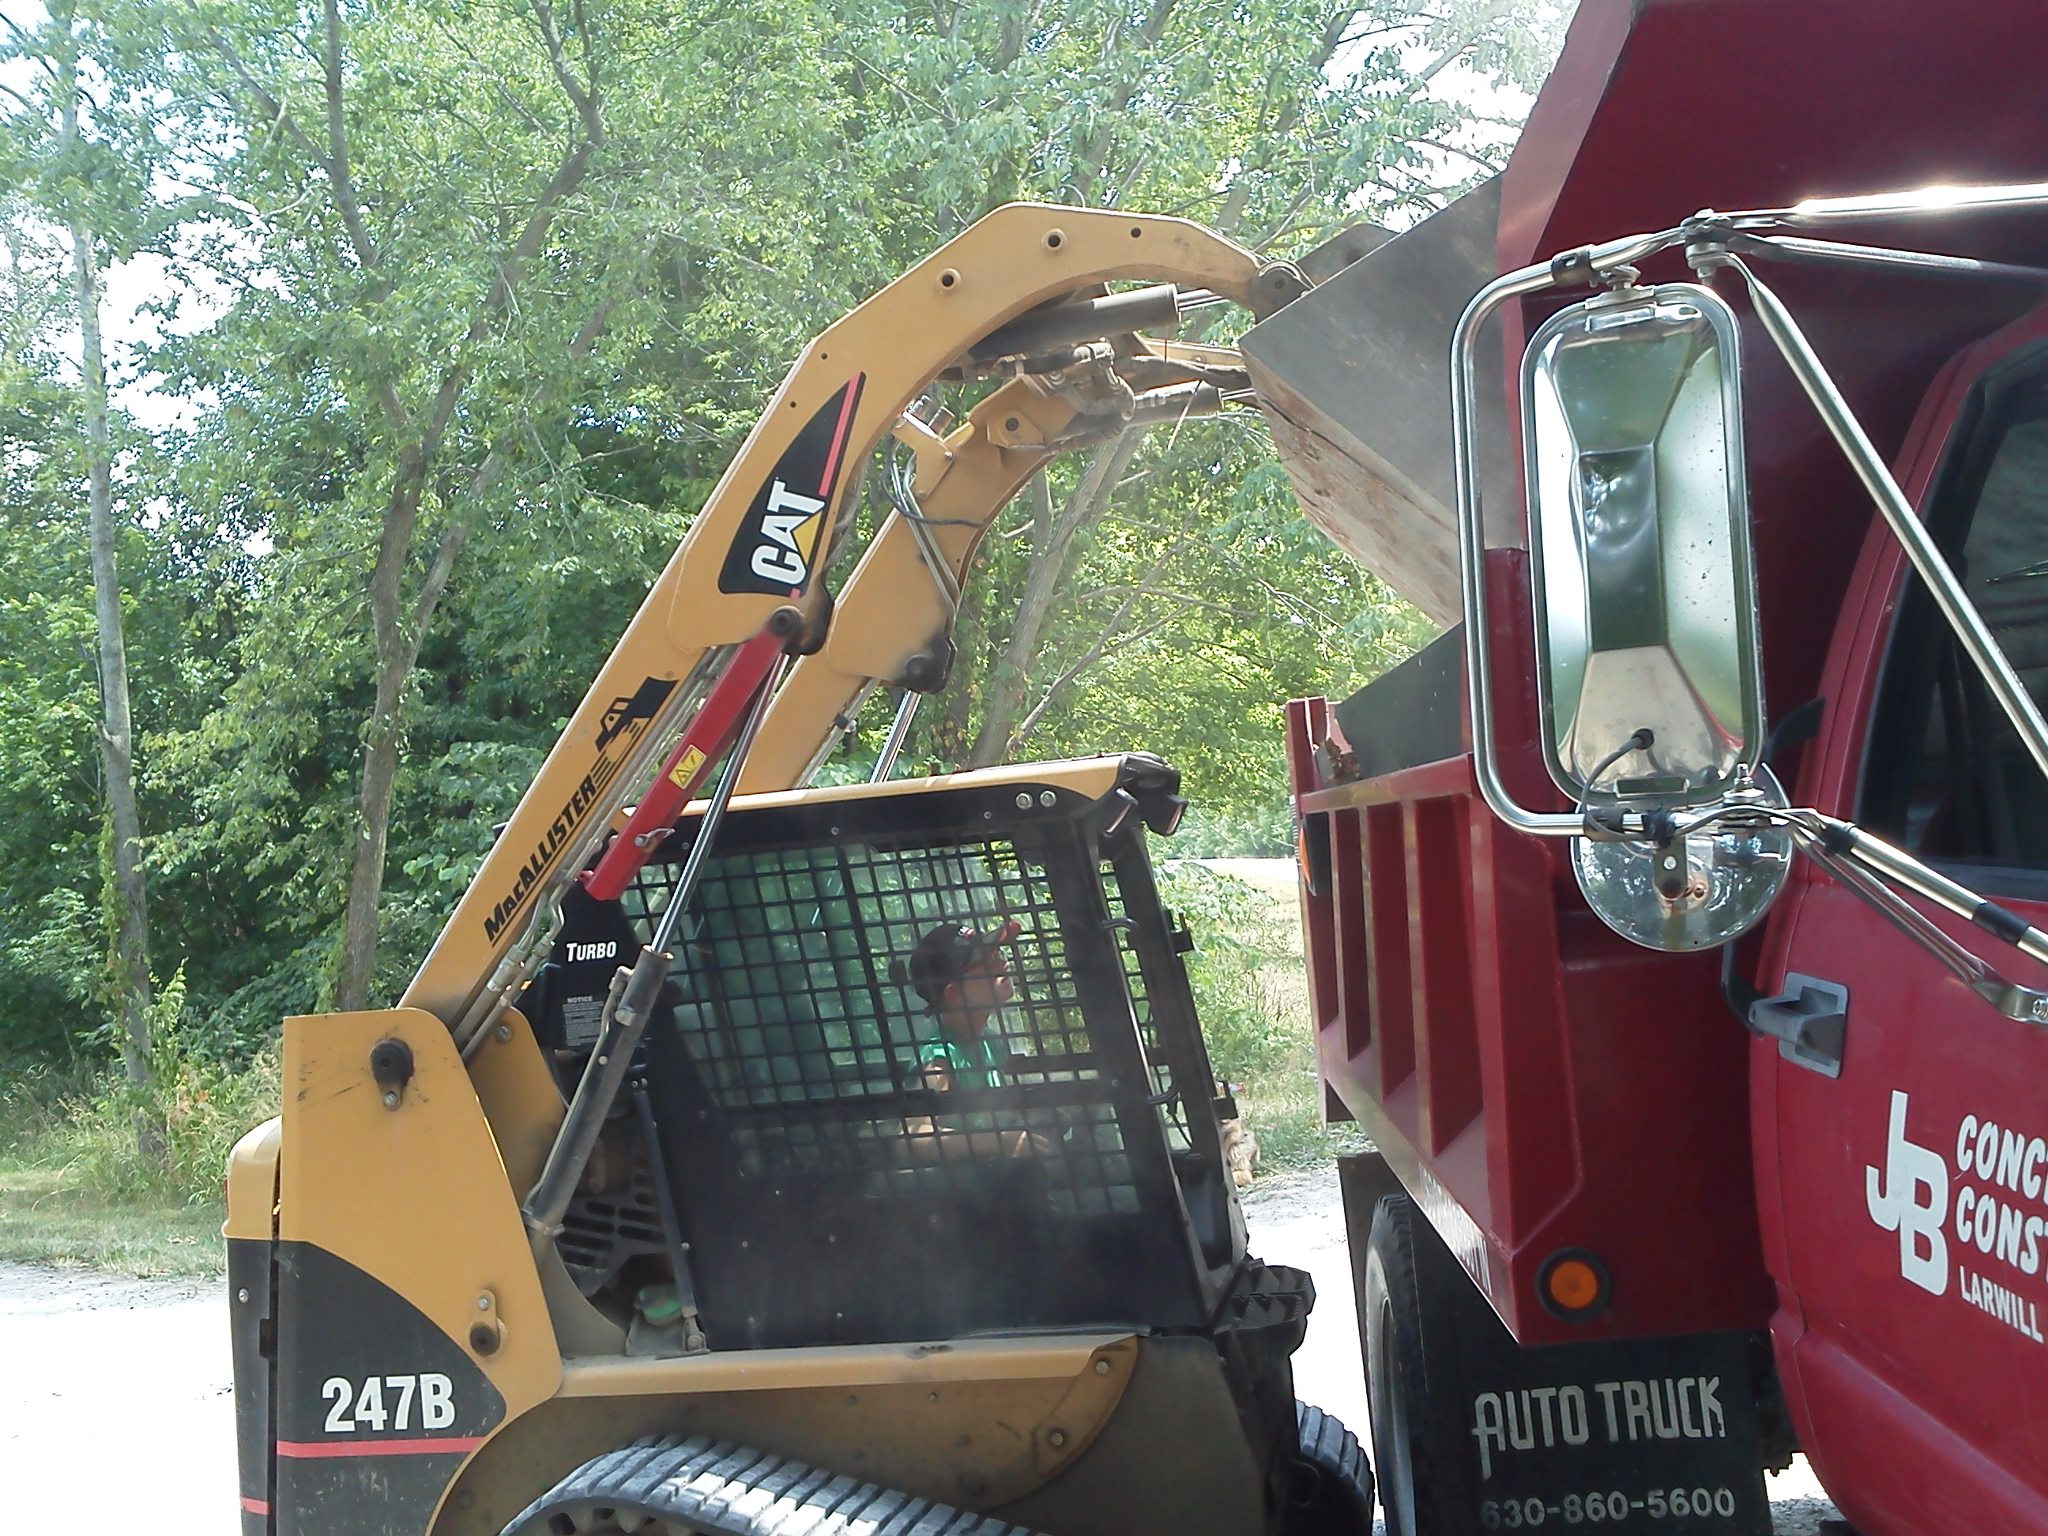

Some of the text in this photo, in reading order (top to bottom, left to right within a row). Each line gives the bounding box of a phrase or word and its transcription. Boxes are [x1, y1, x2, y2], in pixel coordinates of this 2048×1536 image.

[751, 479, 826, 585] CAT
[567, 996, 593, 1004] NOTICE
[1956, 1114, 2048, 1205] CONC
[1959, 1264, 2045, 1344] LARWILL
[322, 1373, 456, 1432] 247B
[1471, 1376, 1726, 1480] AUTO TRUCK
[1480, 1488, 1736, 1529] 630-860-5600
